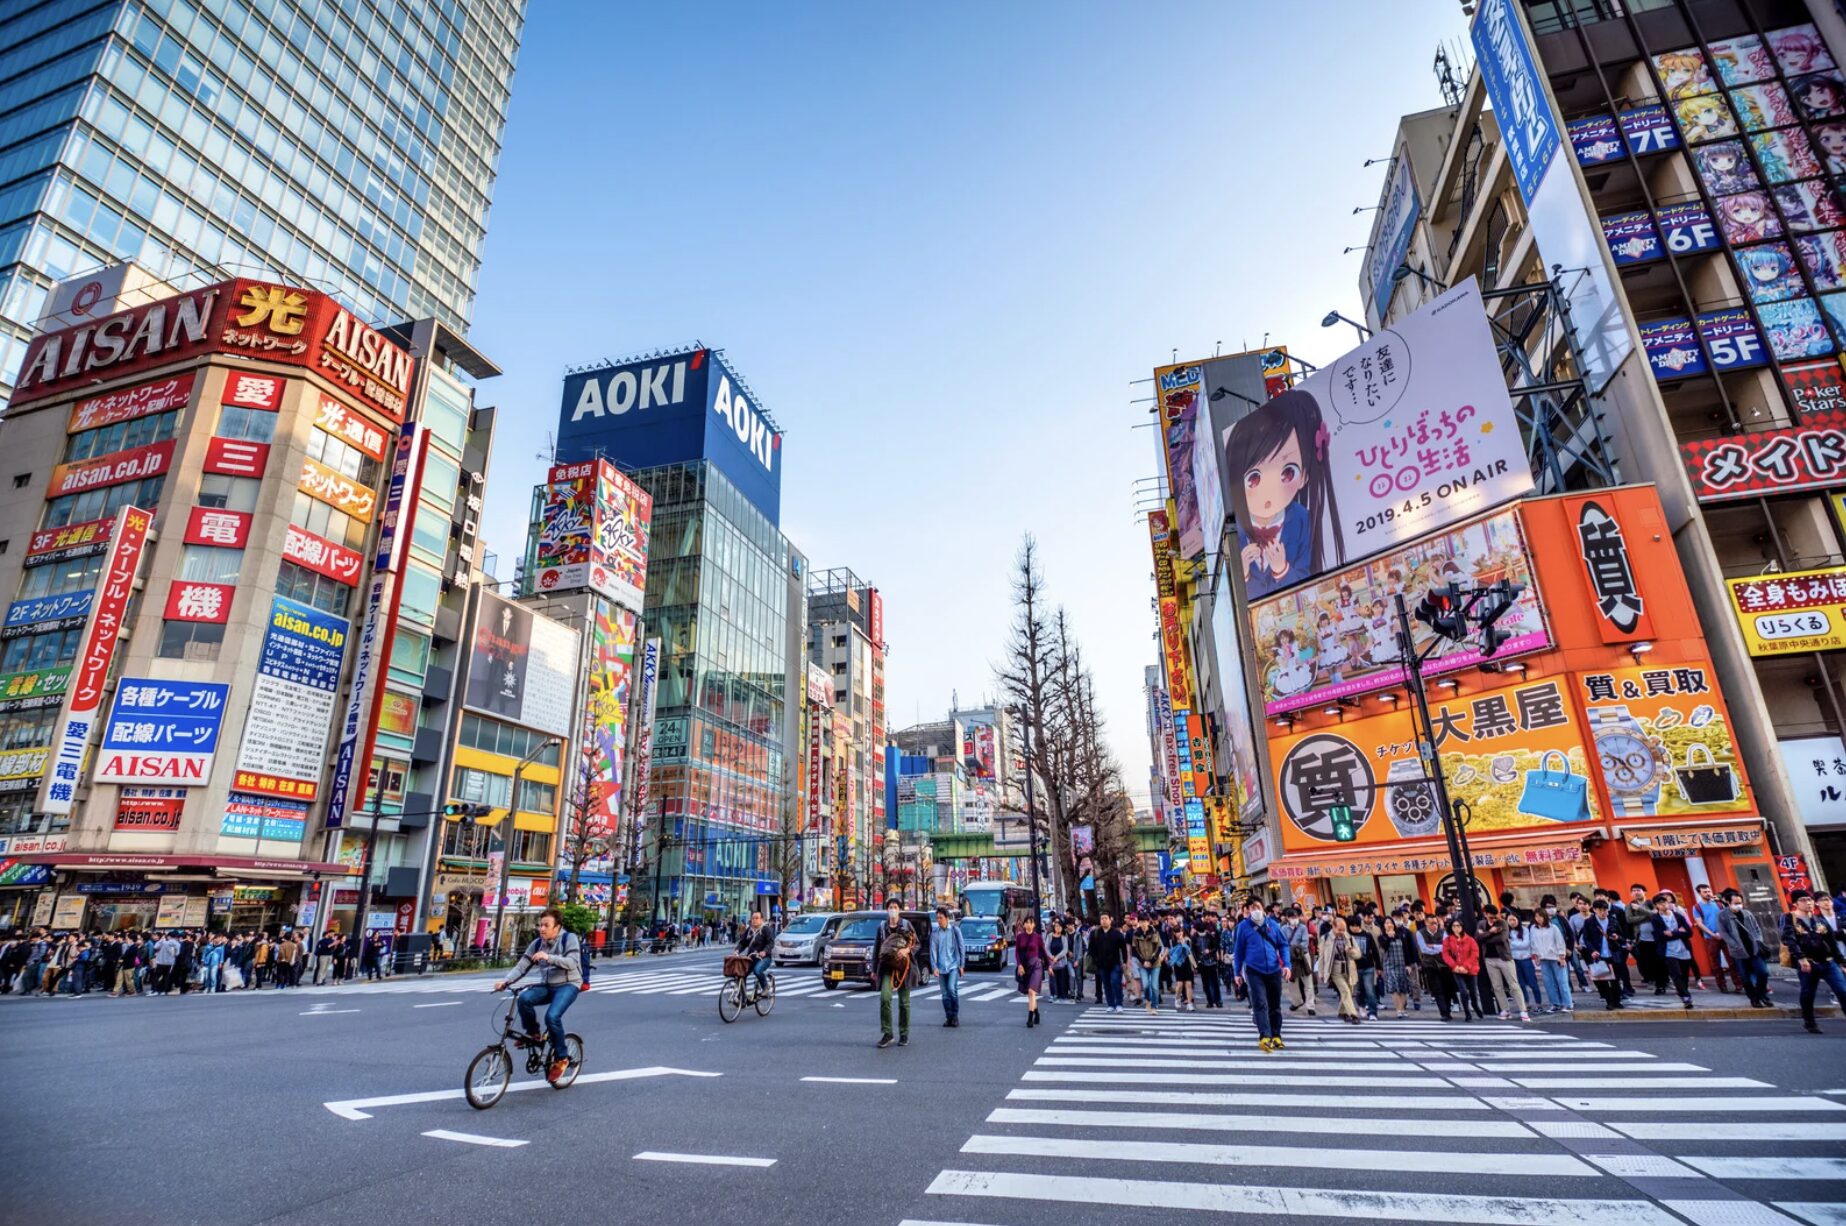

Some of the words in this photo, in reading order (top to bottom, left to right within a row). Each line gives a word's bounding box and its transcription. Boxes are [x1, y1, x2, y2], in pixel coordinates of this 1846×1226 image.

[1567, 118, 1614, 132] トレーディング
[1570, 127, 1617, 142] アメニティ
[1629, 128, 1675, 153] 7F
[1601, 212, 1650, 227] トレーディング
[1604, 223, 1652, 238] アメニティ
[1667, 223, 1716, 252] 6F
[236, 286, 308, 335] 光
[17, 289, 219, 389] AISAN
[222, 329, 307, 355] ネットワーク
[1640, 321, 1690, 335] トレーディング
[1642, 332, 1694, 348] アメニティ
[326, 308, 413, 394] AISAN
[1376, 344, 1396, 386] 友達に
[1710, 334, 1760, 365] 5F
[234, 376, 275, 406] 愛
[571, 361, 687, 422] AOKI
[1360, 357, 1381, 407] なりたい
[72, 399, 99, 430] 光
[1798, 396, 1846, 413] Stars
[316, 401, 384, 454] 光通信
[714, 375, 773, 472] AOKI
[1356, 405, 1476, 470] ひとりぼっちの
[62, 453, 162, 490] aisan.co.jp
[217, 443, 259, 473] 三
[555, 464, 593, 481] 免税店
[1706, 433, 1844, 486] メイド
[300, 463, 374, 514] ネットワーク
[1356, 491, 1432, 535] 2019.4.5
[1437, 476, 1468, 498] ON
[1473, 459, 1508, 485] AIR
[32, 533, 52, 550] 3F
[199, 511, 241, 545] 電
[283, 528, 360, 577] 配線パーツ
[9, 605, 30, 622] 2F
[30, 593, 94, 620] ネットワーク
[79, 514, 145, 702] 光・ケーブル・ネットワーク
[178, 586, 222, 619] 機
[274, 613, 344, 648] aisan.co.jp
[1761, 616, 1823, 635] りらくる
[1757, 636, 1842, 652] 秋葉原中央通り店
[645, 643, 657, 683] AKKY
[120, 685, 222, 712] 各種ケーブル
[660, 721, 676, 735] 24
[1430, 681, 1569, 750] 大黒屋
[111, 722, 214, 745] 配線パーツ
[658, 735, 681, 743] OPEN
[50, 721, 89, 802] 愛三電機
[101, 755, 206, 778] AISAN
[1166, 732, 1177, 777] Tax-free
[330, 745, 352, 820] AISAN
[1170, 778, 1182, 811] Shop
[1290, 744, 1370, 831] 質
[118, 808, 182, 828] aisan.co.jp
[1525, 847, 1580, 863] 無料査定
[1779, 857, 1799, 870] 4F
[533, 886, 546, 895] au
